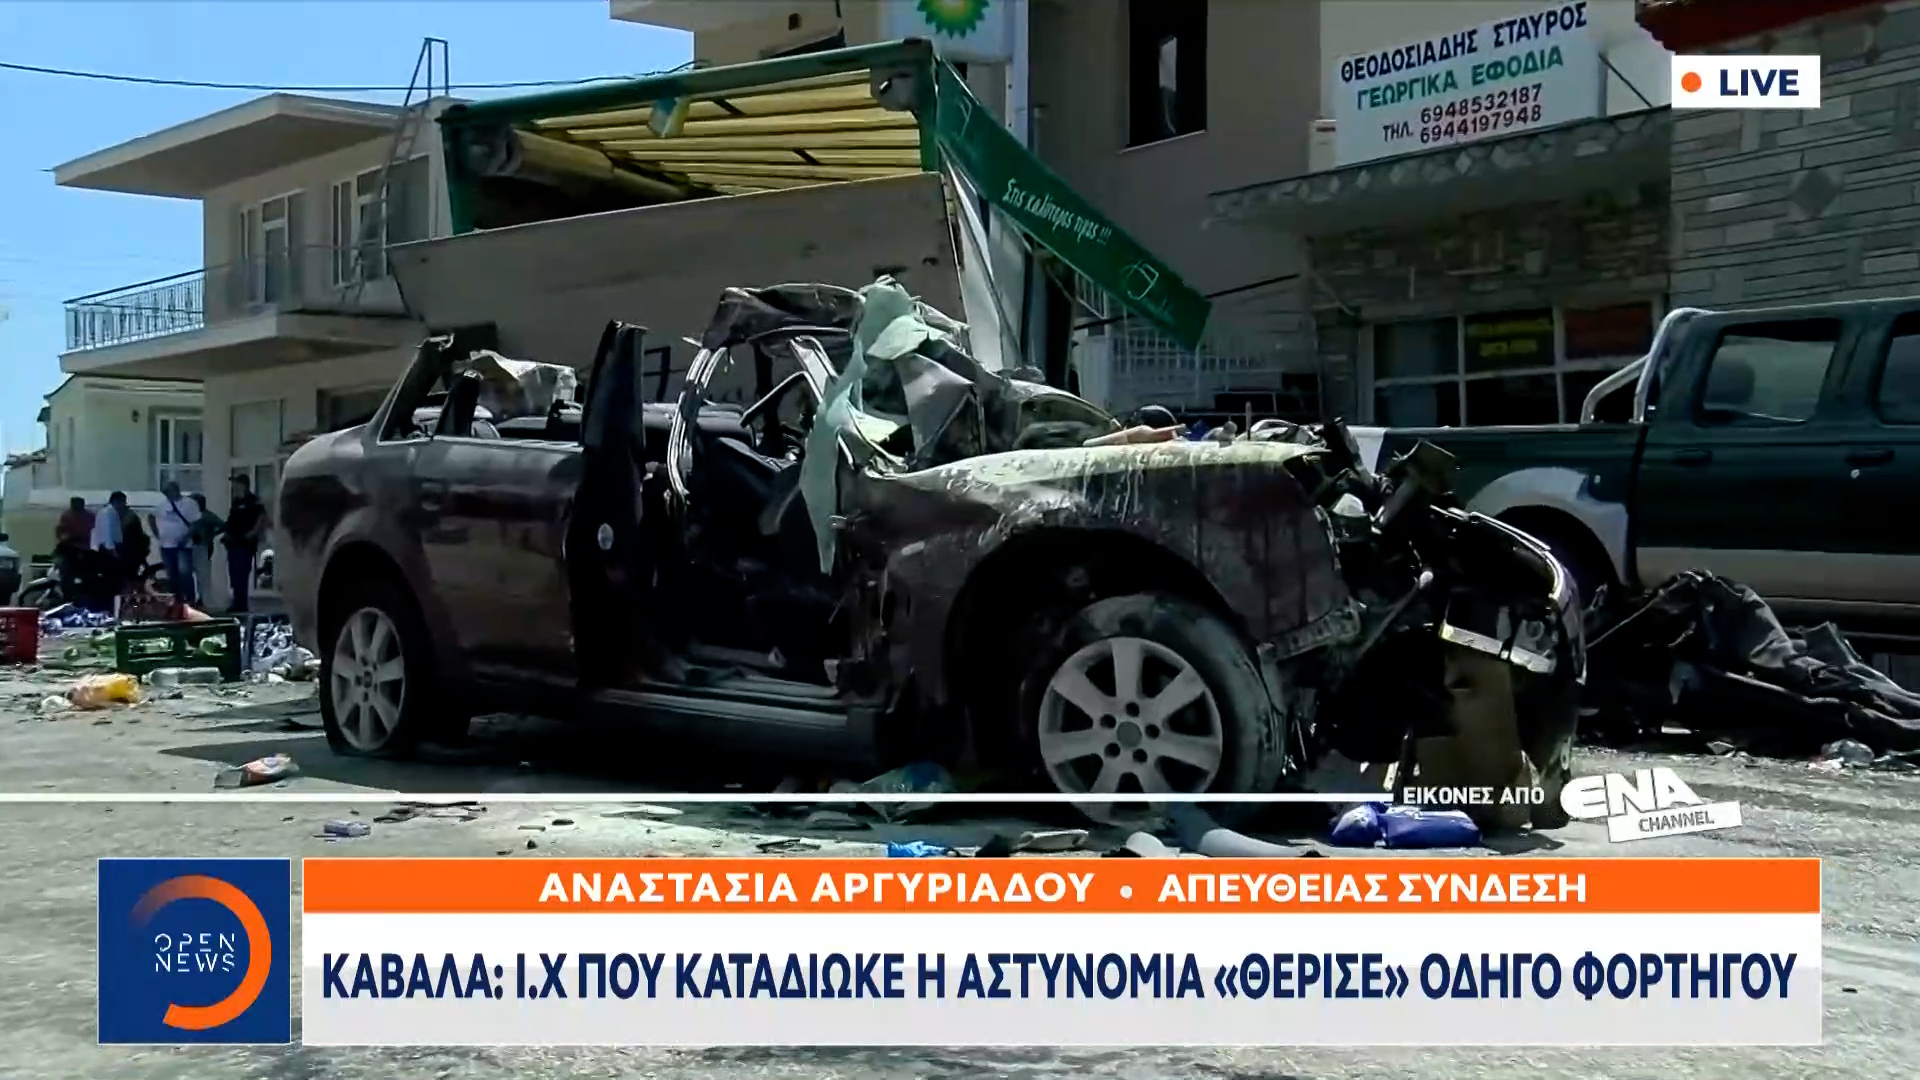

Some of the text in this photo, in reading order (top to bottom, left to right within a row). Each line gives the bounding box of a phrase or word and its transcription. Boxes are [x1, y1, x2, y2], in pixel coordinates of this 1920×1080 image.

[1341, 2, 1587, 83] ΘΕΟΔΟΣΙΑΔΗΣ ΣΤΑΥΡΟΣ
[1357, 46, 1564, 110] ΓΕΩΡΓΙΚΑ ΕΦΟΔΙΑ
[1382, 83, 1542, 142] ΤΗΛ. 6948532187
[1420, 105, 1542, 143] 6944197948
